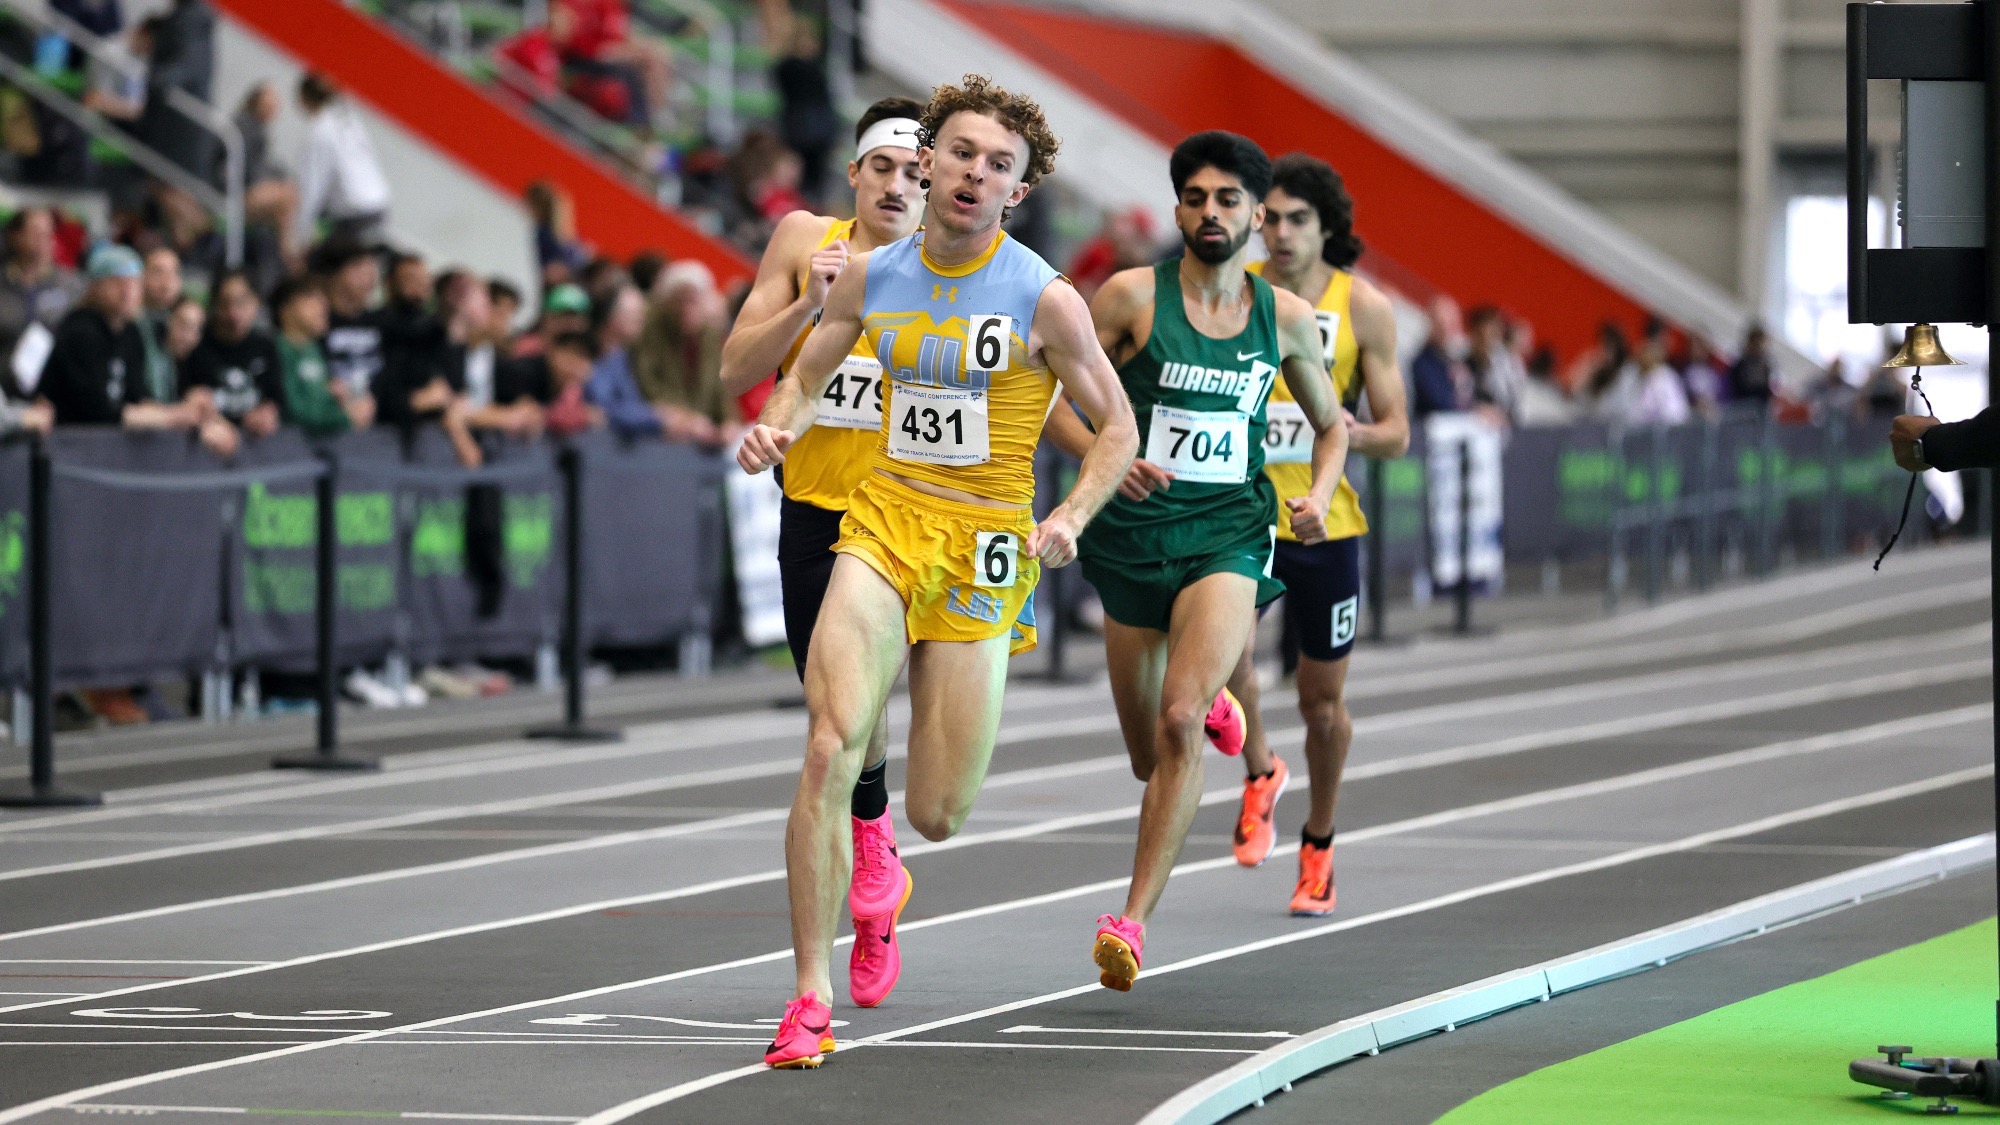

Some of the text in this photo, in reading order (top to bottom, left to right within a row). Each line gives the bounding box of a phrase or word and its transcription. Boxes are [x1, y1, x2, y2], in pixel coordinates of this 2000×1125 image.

[877, 328, 992, 391] LIU
[976, 318, 1001, 369] 6
[903, 388, 928, 399] NORTHEAST
[1158, 361, 1252, 397] WAGNE
[1252, 370, 1272, 412] 1
[902, 405, 963, 445] 431
[1169, 426, 1233, 462] 704
[1265, 419, 1304, 447] 67
[984, 535, 1009, 583] 6
[946, 586, 1004, 625] LIU
[1337, 604, 1352, 639] 5
